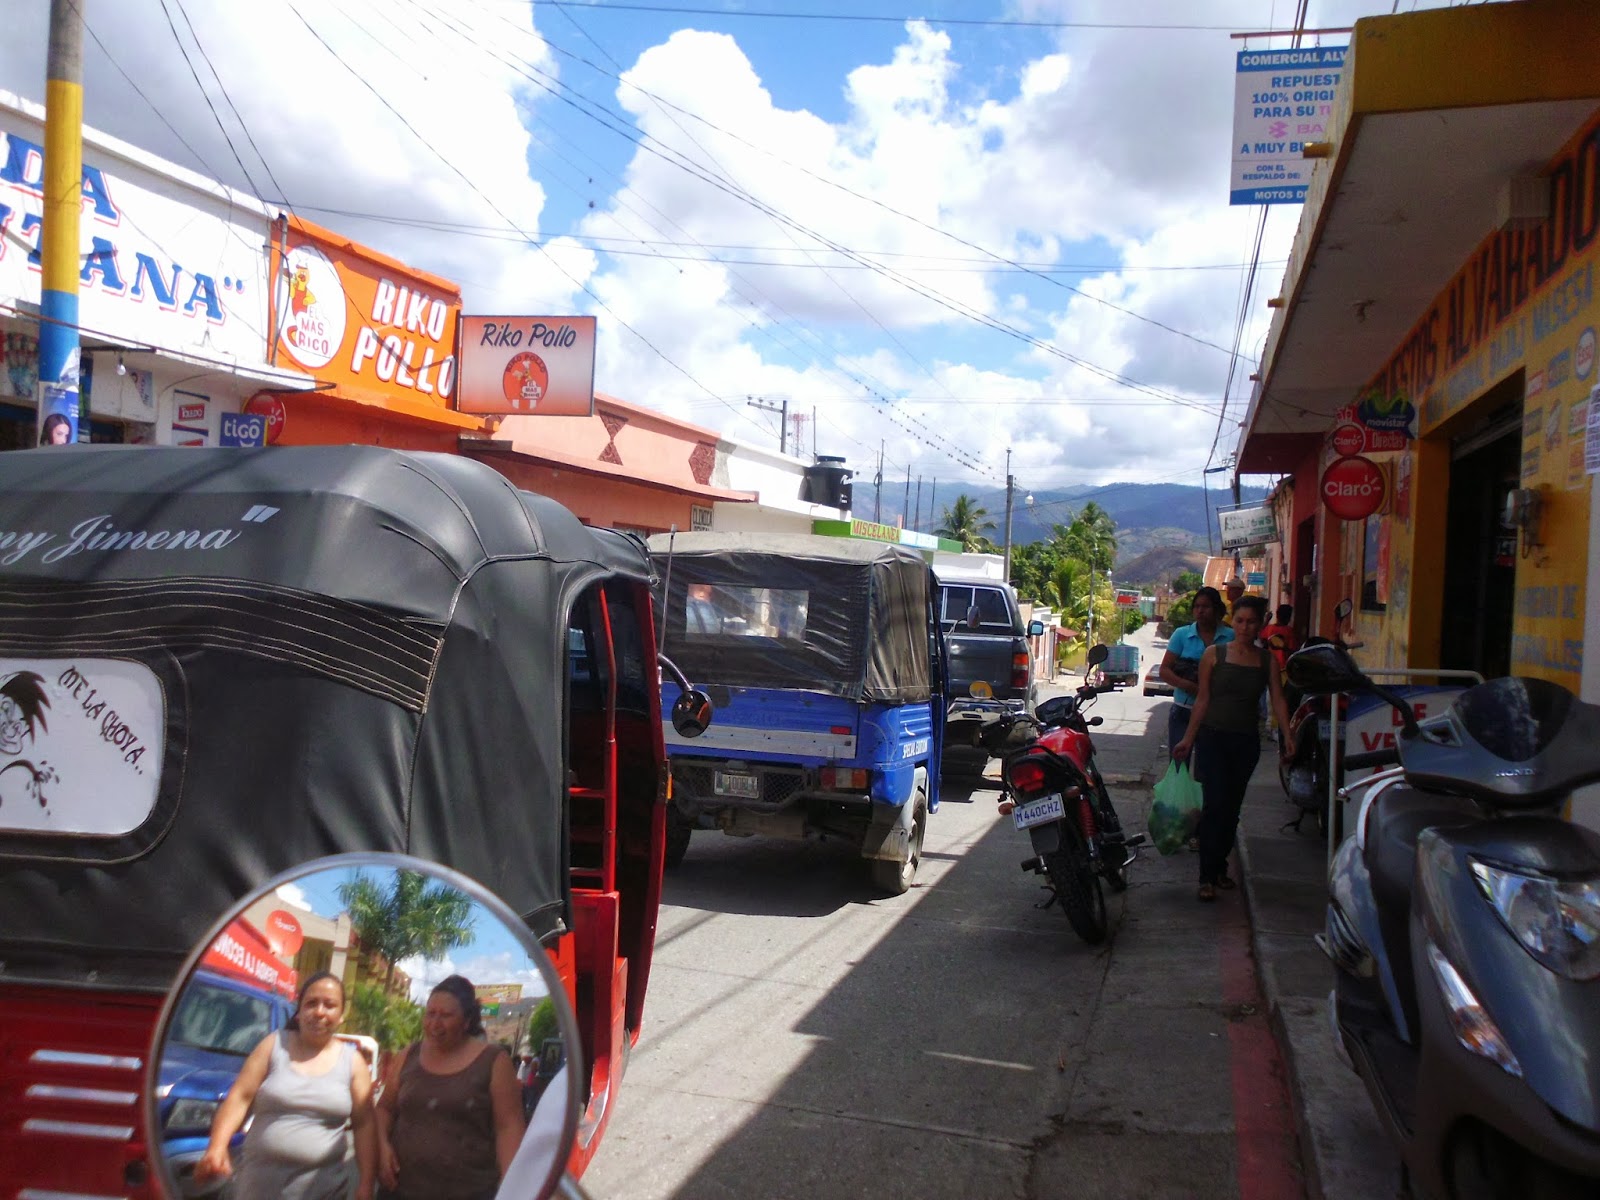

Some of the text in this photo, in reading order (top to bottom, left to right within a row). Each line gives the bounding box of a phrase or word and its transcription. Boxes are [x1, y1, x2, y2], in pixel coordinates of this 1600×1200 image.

[1242, 52, 1320, 66] COMERCIAL
[1252, 92, 1289, 104] 100%
[1253, 106, 1292, 118] PARA
[1296, 106, 1315, 116] SU
[1240, 144, 1250, 154] A
[1254, 142, 1285, 154] MUY
[1254, 191, 1293, 200] MOTOS
[371, 277, 447, 343] RIKO
[301, 318, 324, 336] MAS
[480, 323, 577, 348] Riko Pollo
[298, 330, 329, 355] RICO
[350, 327, 456, 399] POLLO
[505, 354, 546, 373] RIKO POLLO
[1366, 418, 1405, 428] movistar
[1333, 437, 1358, 445] Claro
[1324, 480, 1373, 496] Claro
[852, 519, 900, 541] MISCELANEA
[58, 664, 89, 700] ME
[82, 689, 106, 720] LA
